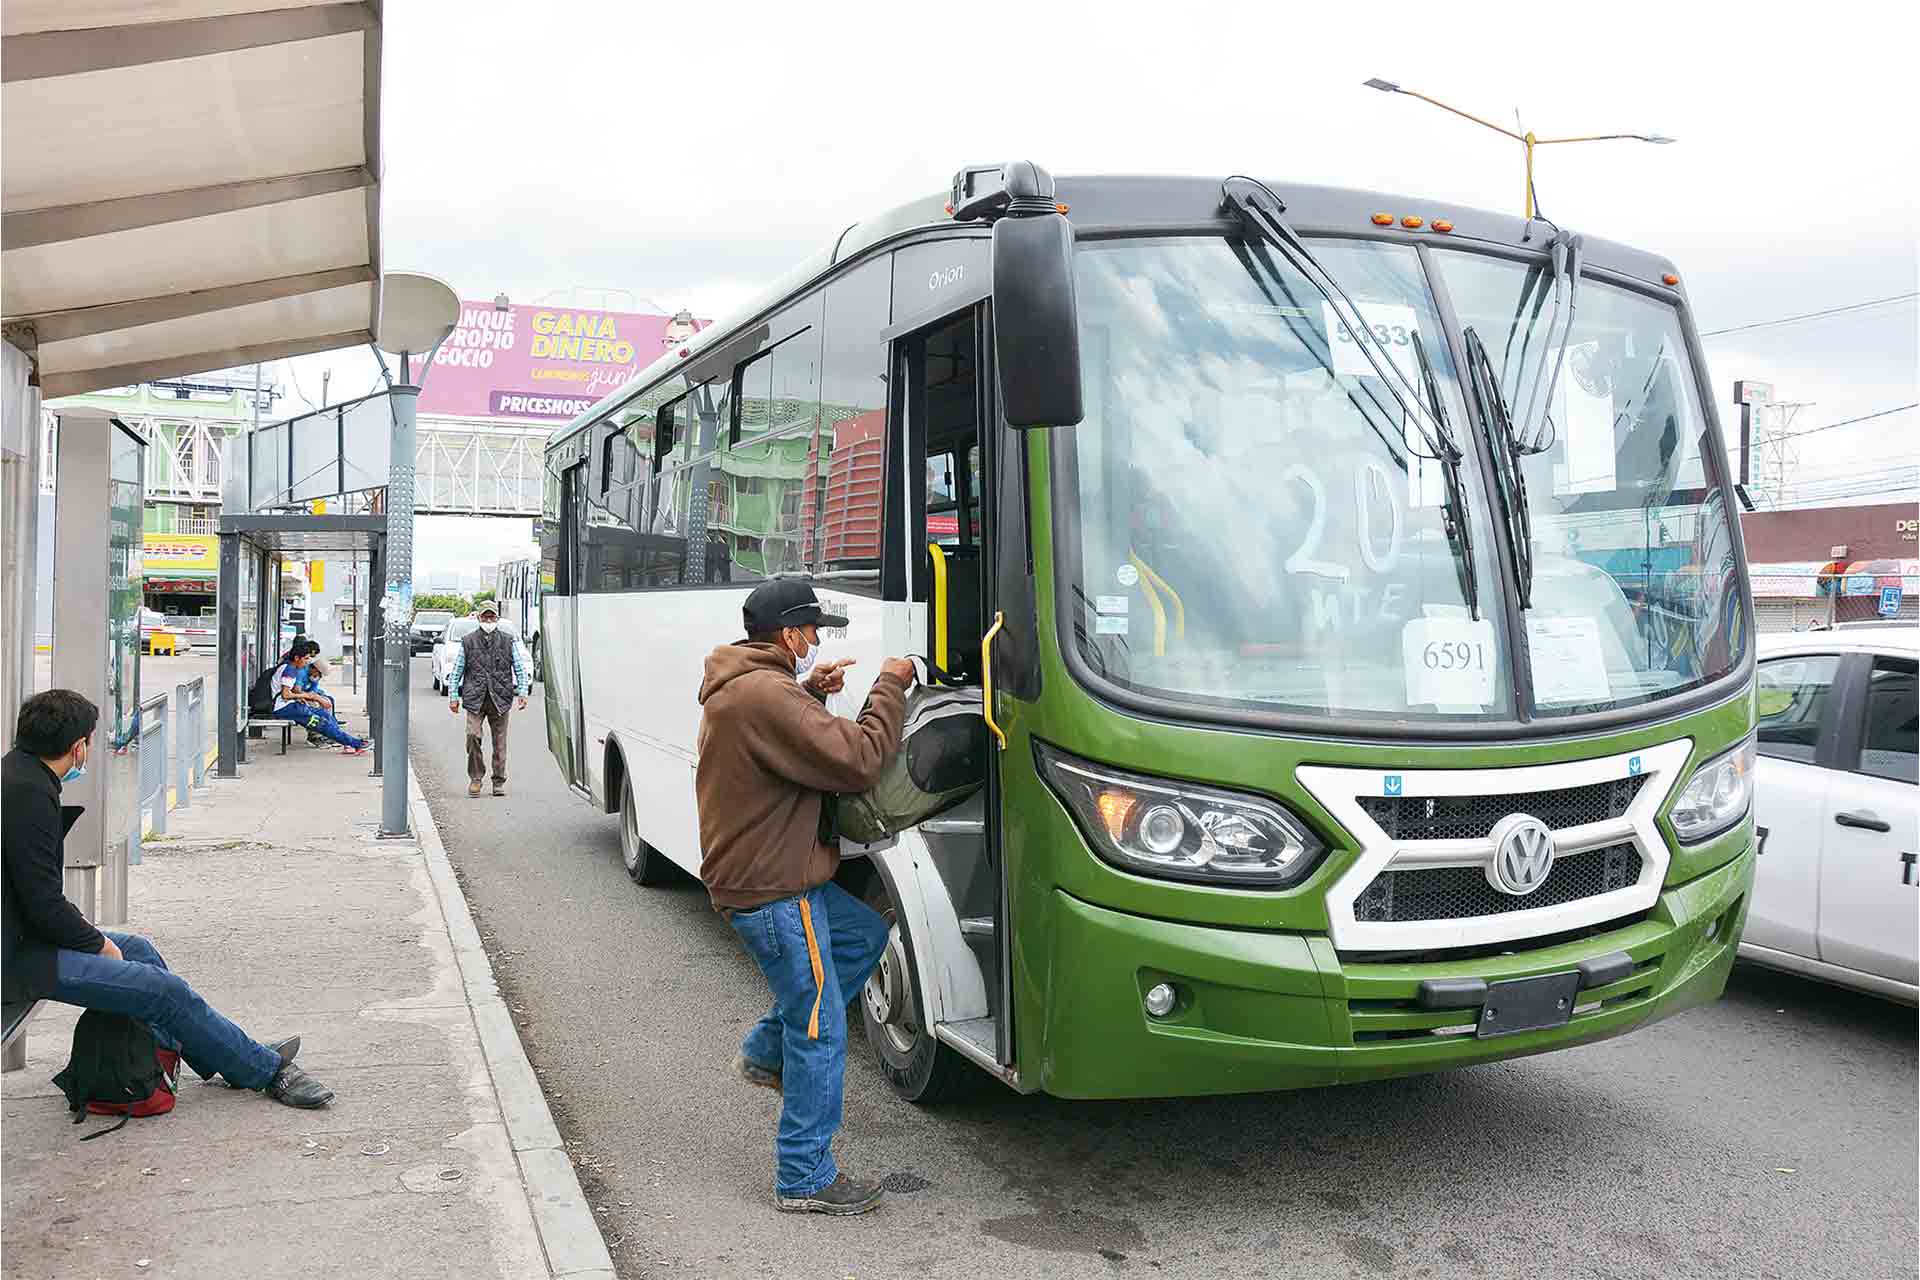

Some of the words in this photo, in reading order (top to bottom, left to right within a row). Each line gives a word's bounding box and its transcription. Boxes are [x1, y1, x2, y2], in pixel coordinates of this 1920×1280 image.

[928, 265, 964, 289] Orion
[531, 311, 618, 339] GANA
[1336, 321, 1410, 346] 5133
[530, 335, 635, 365] DINERO
[499, 395, 591, 416] PRICESHOES
[1283, 454, 1403, 584] 20
[1423, 641, 1485, 670] 6591
